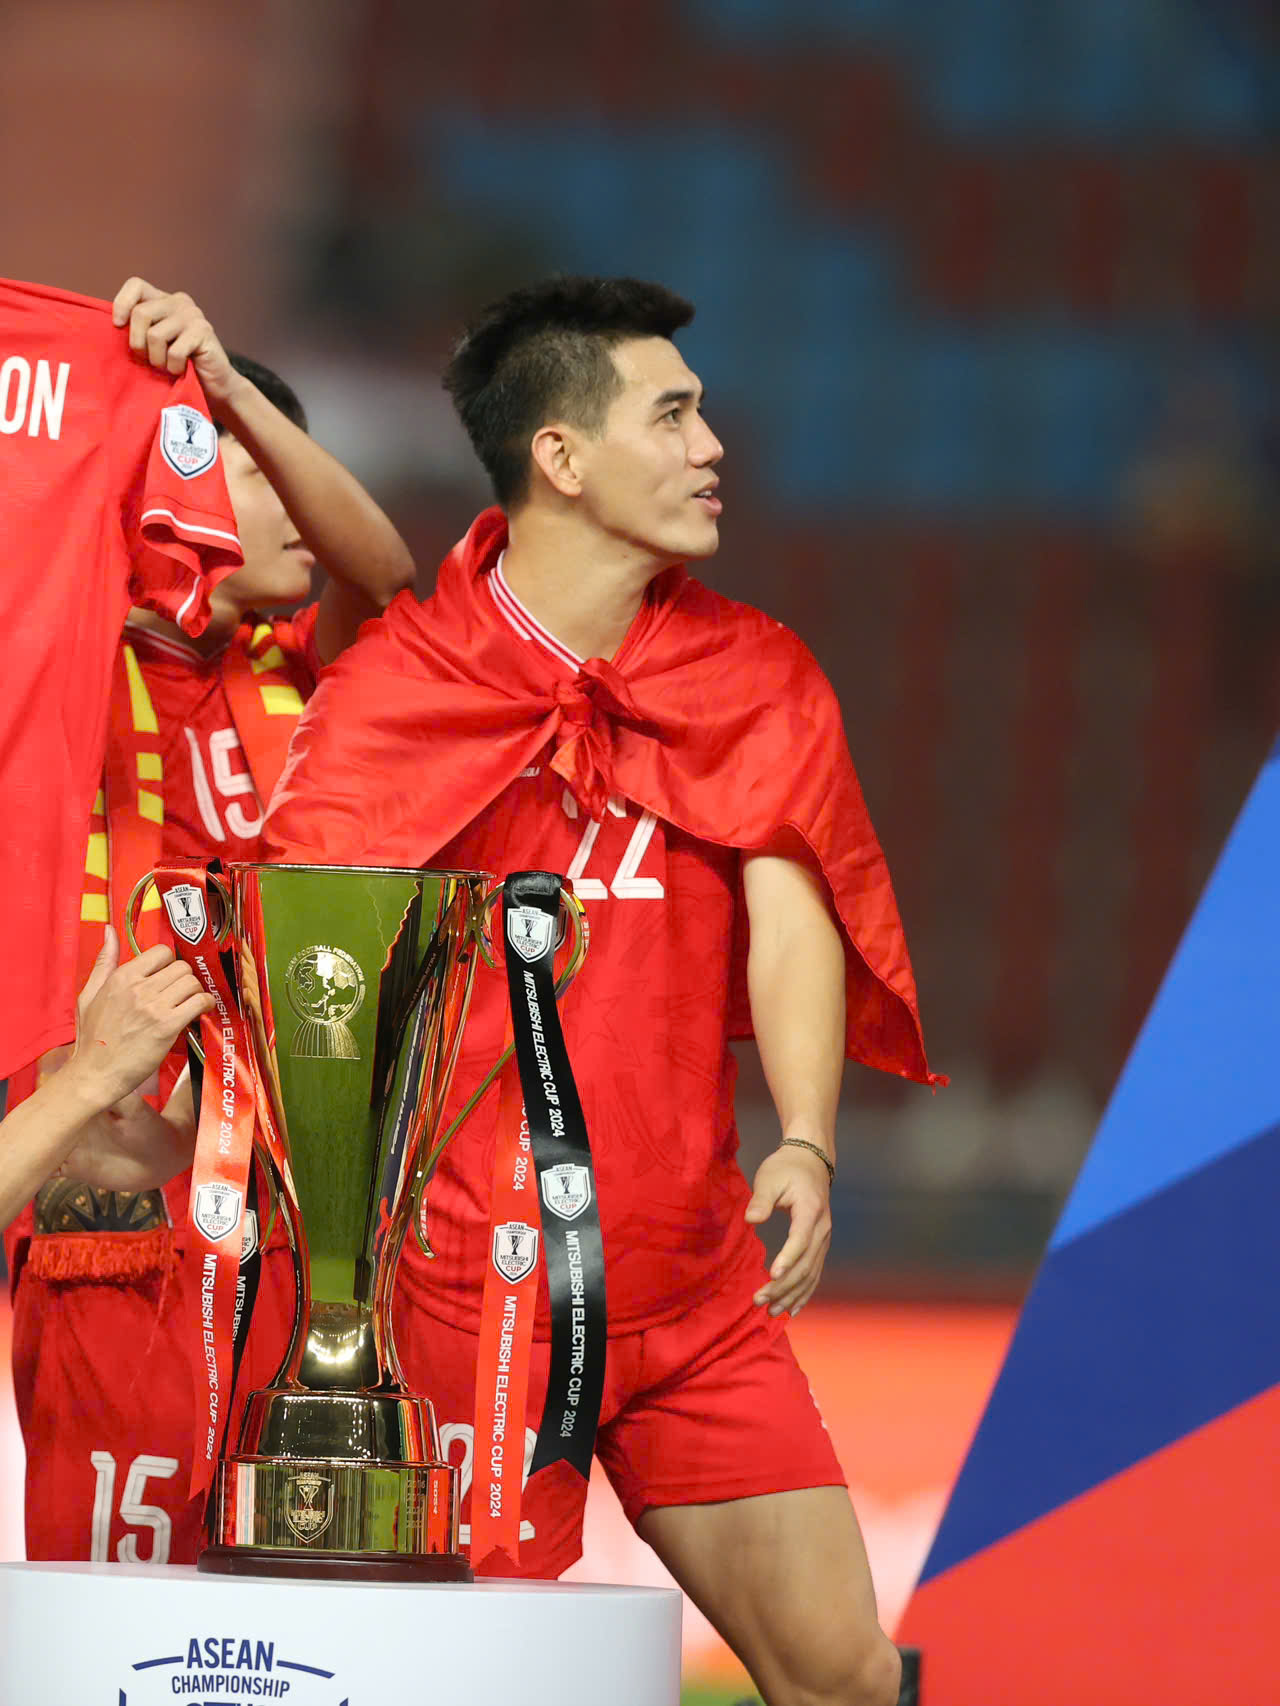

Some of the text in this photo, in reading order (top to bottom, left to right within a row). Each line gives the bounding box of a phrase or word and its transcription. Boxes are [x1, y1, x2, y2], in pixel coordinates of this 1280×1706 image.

[184, 726, 265, 842] 15
[520, 945, 536, 953] CUP
[523, 970, 543, 1031] MITSUBISHI
[194, 955, 236, 1155] MITSUBISHI ELECTRIC CUP 2024
[532, 1030, 554, 1081] ELECTRIC
[543, 1081, 560, 1106] CUP
[518, 1120, 531, 1152] CUP
[548, 1108, 565, 1138] 2024
[512, 1157, 528, 1191] 2024
[565, 1230, 585, 1306] MITSUBISHI
[202, 1253, 219, 1461] MITSUBISHI ELECTRIC CUP 2024
[571, 1307, 585, 1375] ELECTRIC
[490, 1295, 517, 1518] MITSUBISHI ELECTRIC CUP 2024
[567, 1377, 582, 1406] CUP
[560, 1409, 577, 1438] 2024
[90, 1451, 179, 1563] 15
[186, 1637, 275, 1672] ASEAN
[171, 1674, 290, 1698] CHAMPIONSHIP
